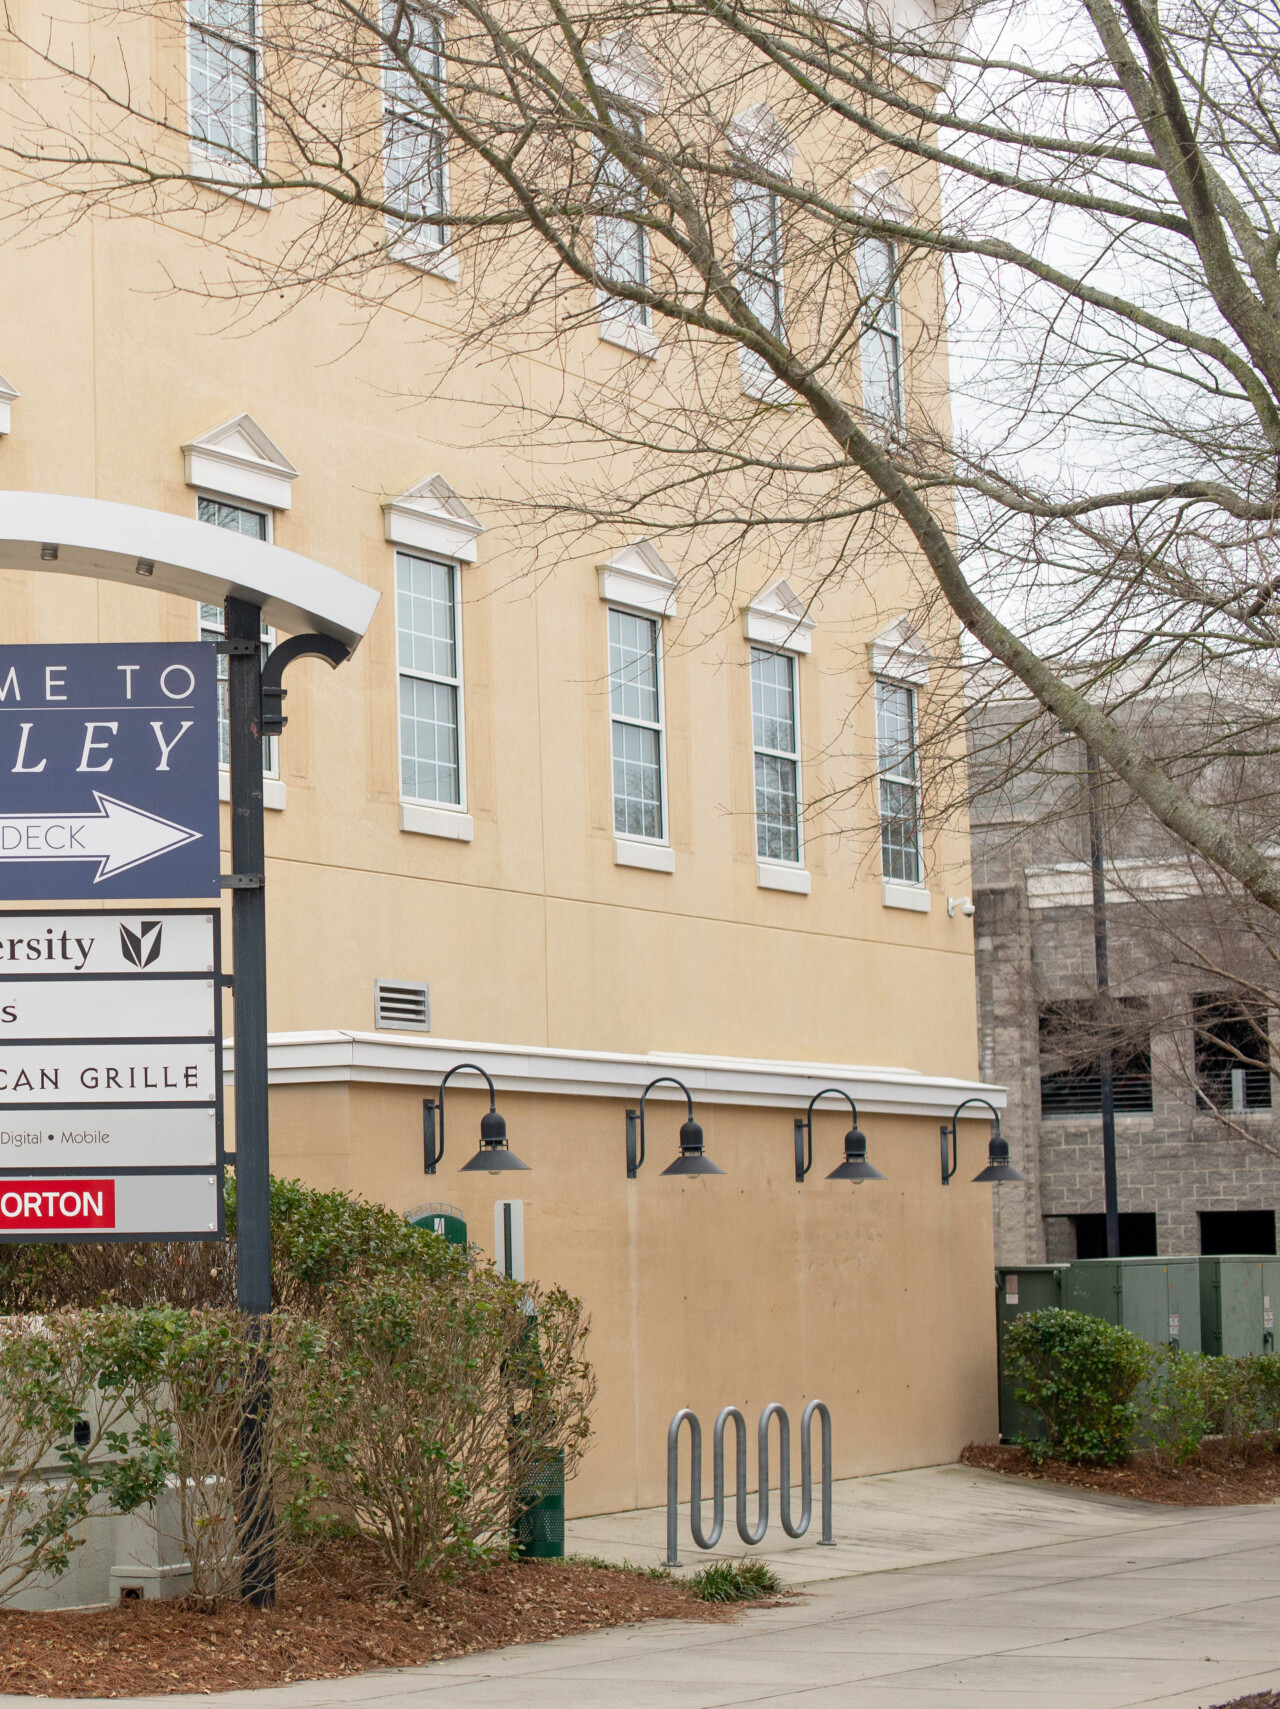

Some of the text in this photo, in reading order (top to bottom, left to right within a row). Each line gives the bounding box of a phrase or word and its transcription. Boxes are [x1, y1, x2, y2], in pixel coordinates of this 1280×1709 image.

[117, 665, 195, 699] TO
[2, 825, 85, 850] DECK
[80, 1065, 198, 1089] GRILLE
[1, 1131, 42, 1147] Digital
[61, 1130, 110, 1144] Mobile
